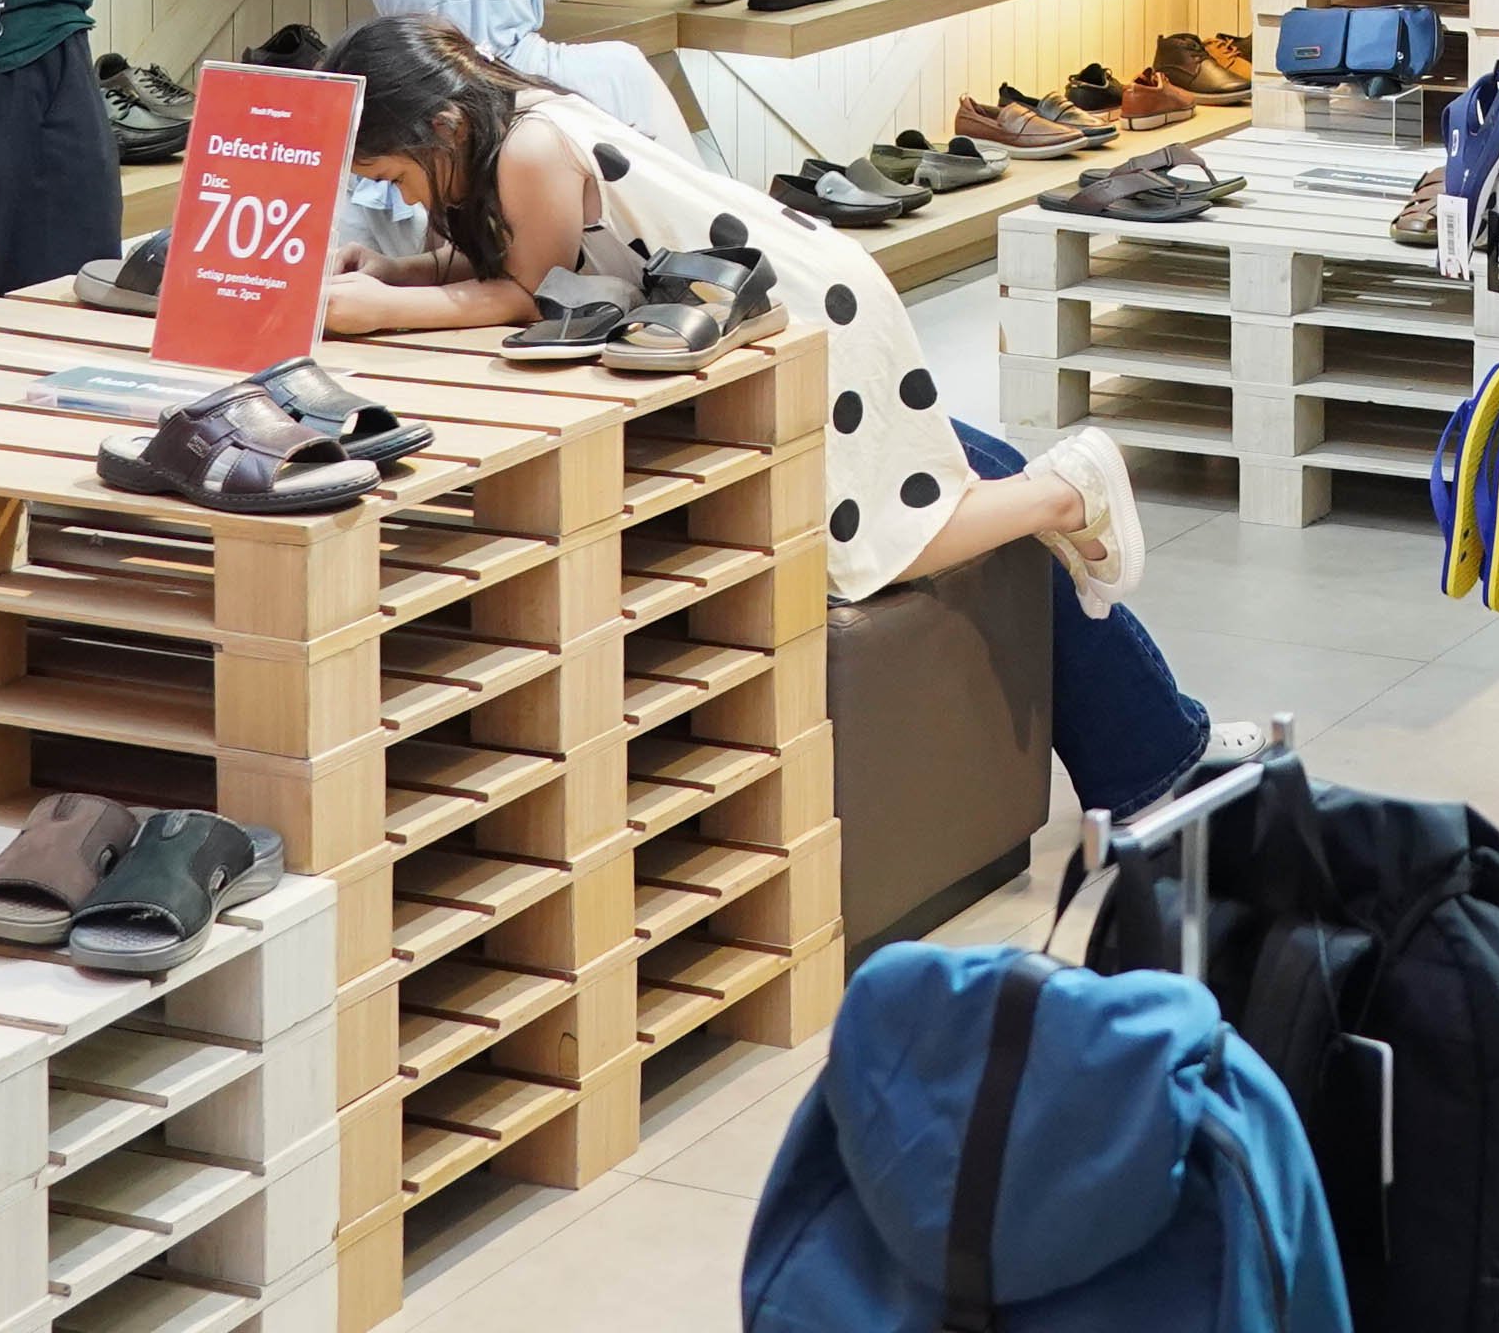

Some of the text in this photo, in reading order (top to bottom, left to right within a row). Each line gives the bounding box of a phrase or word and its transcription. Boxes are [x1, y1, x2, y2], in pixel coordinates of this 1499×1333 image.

[207, 134, 322, 167] Defect items
[201, 173, 231, 190] Disc.
[193, 191, 311, 265] 70%
[239, 288, 262, 301] 2pcs
